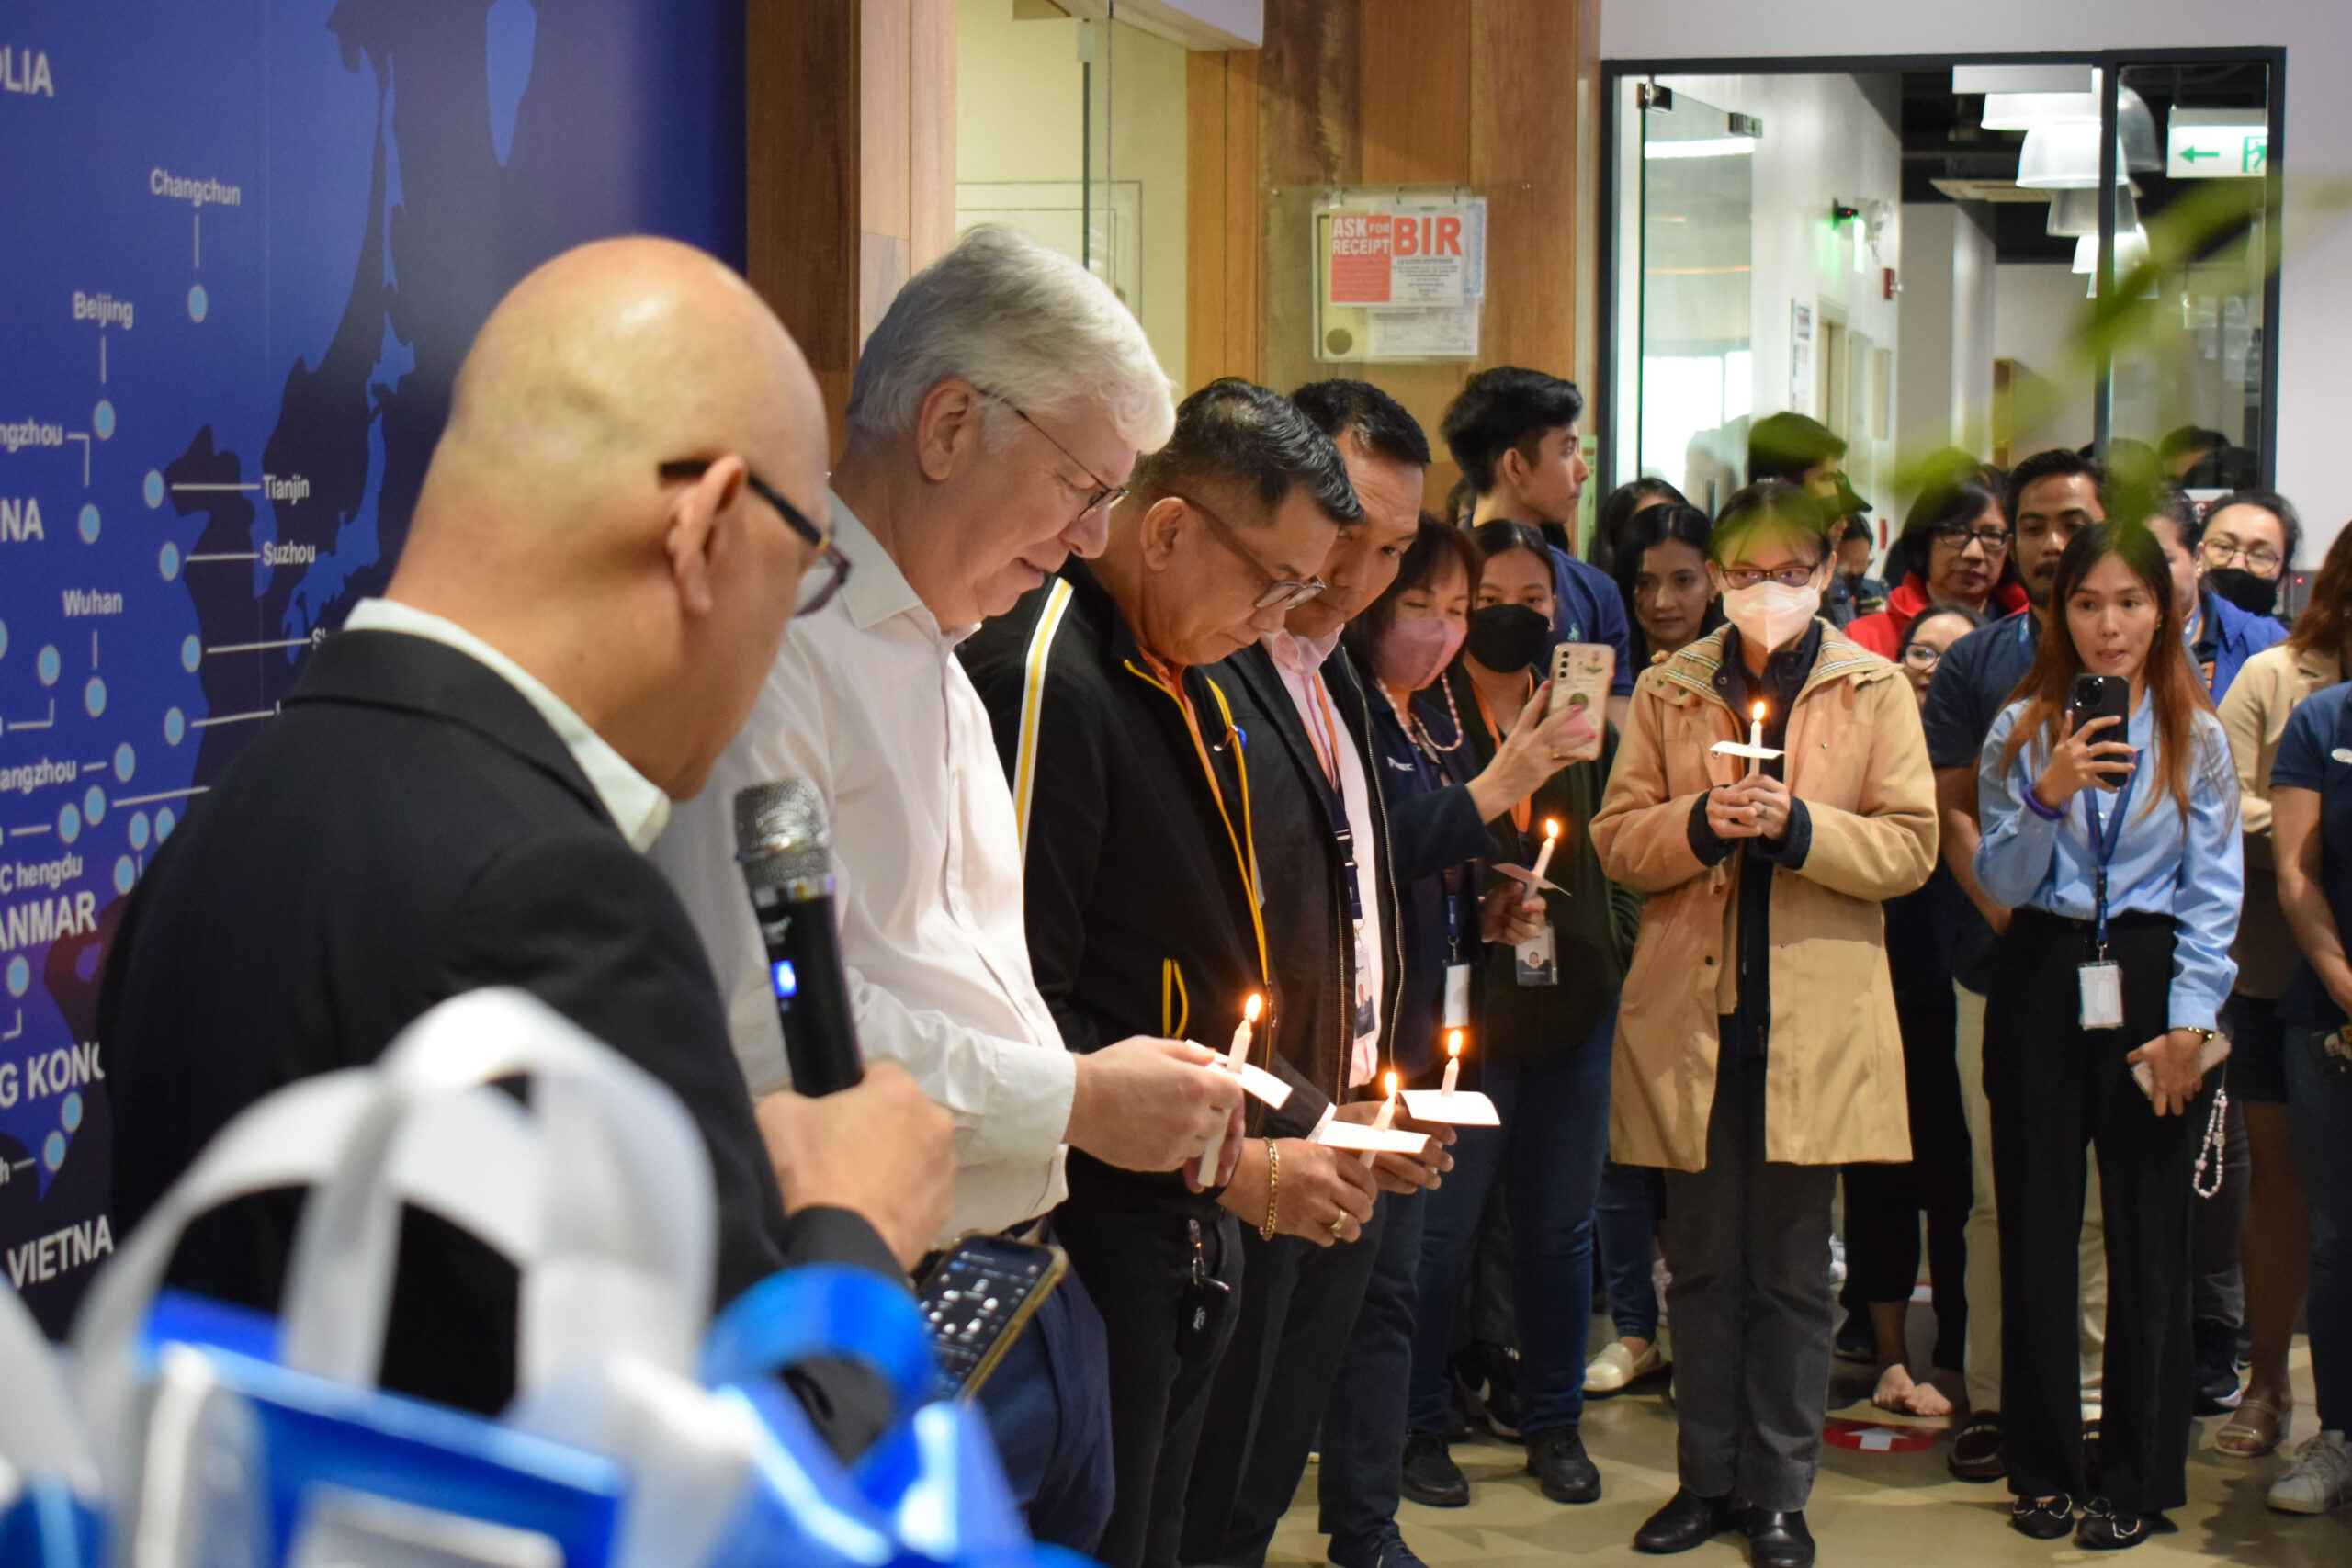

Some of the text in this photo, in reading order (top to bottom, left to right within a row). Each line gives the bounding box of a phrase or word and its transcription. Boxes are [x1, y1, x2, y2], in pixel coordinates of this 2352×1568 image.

[0, 45, 54, 97] LIA
[150, 167, 241, 207] Changchun
[1333, 217, 1390, 238] ASK FOR
[1393, 216, 1462, 256] BIR
[1333, 238, 1391, 255] RECEIPT
[73, 290, 134, 330] Beijing
[264, 474, 310, 505] Tianjin
[263, 542, 315, 566] Suzhou
[63, 589, 123, 617] Wuhan
